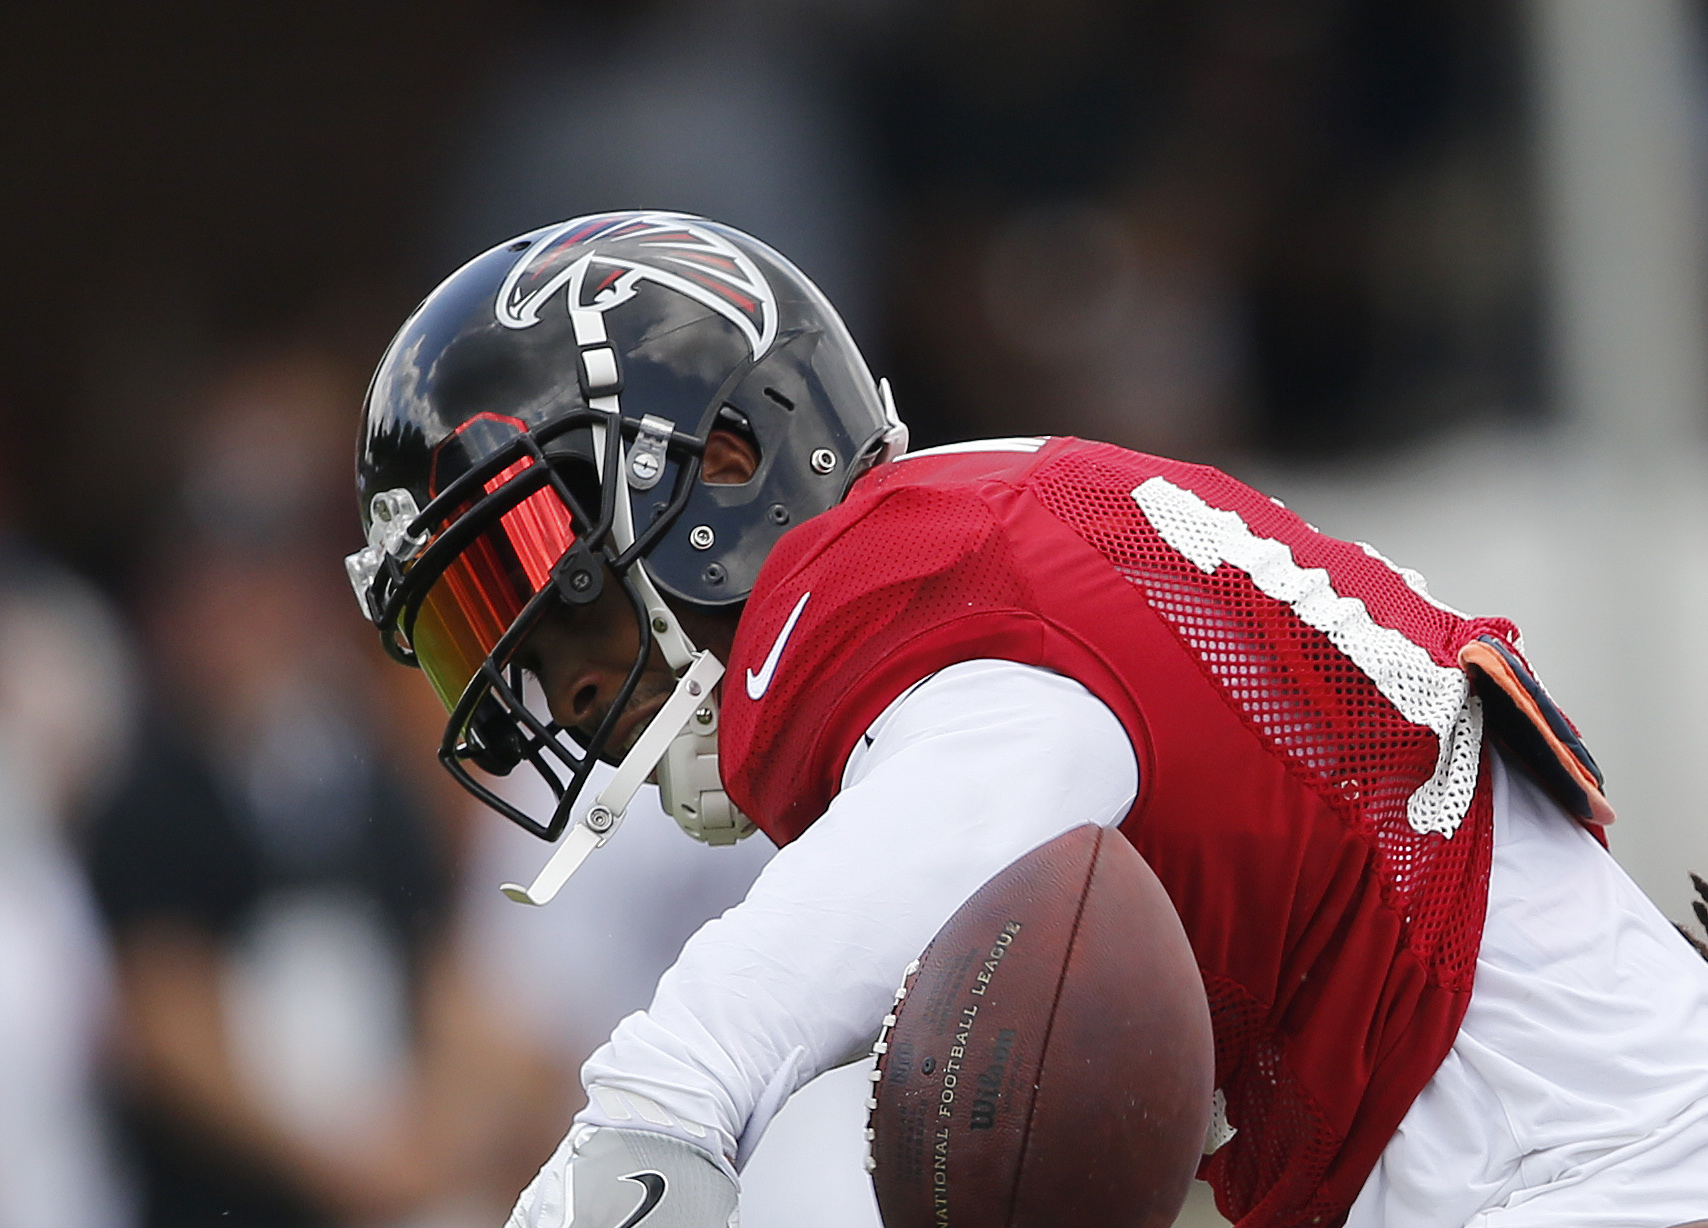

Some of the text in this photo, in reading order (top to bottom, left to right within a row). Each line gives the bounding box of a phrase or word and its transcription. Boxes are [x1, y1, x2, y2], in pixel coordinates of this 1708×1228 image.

[939, 1004, 979, 1117] FOOTBALL
[971, 921, 1021, 996] LEAGUE
[969, 1029, 1016, 1131] Wilson
